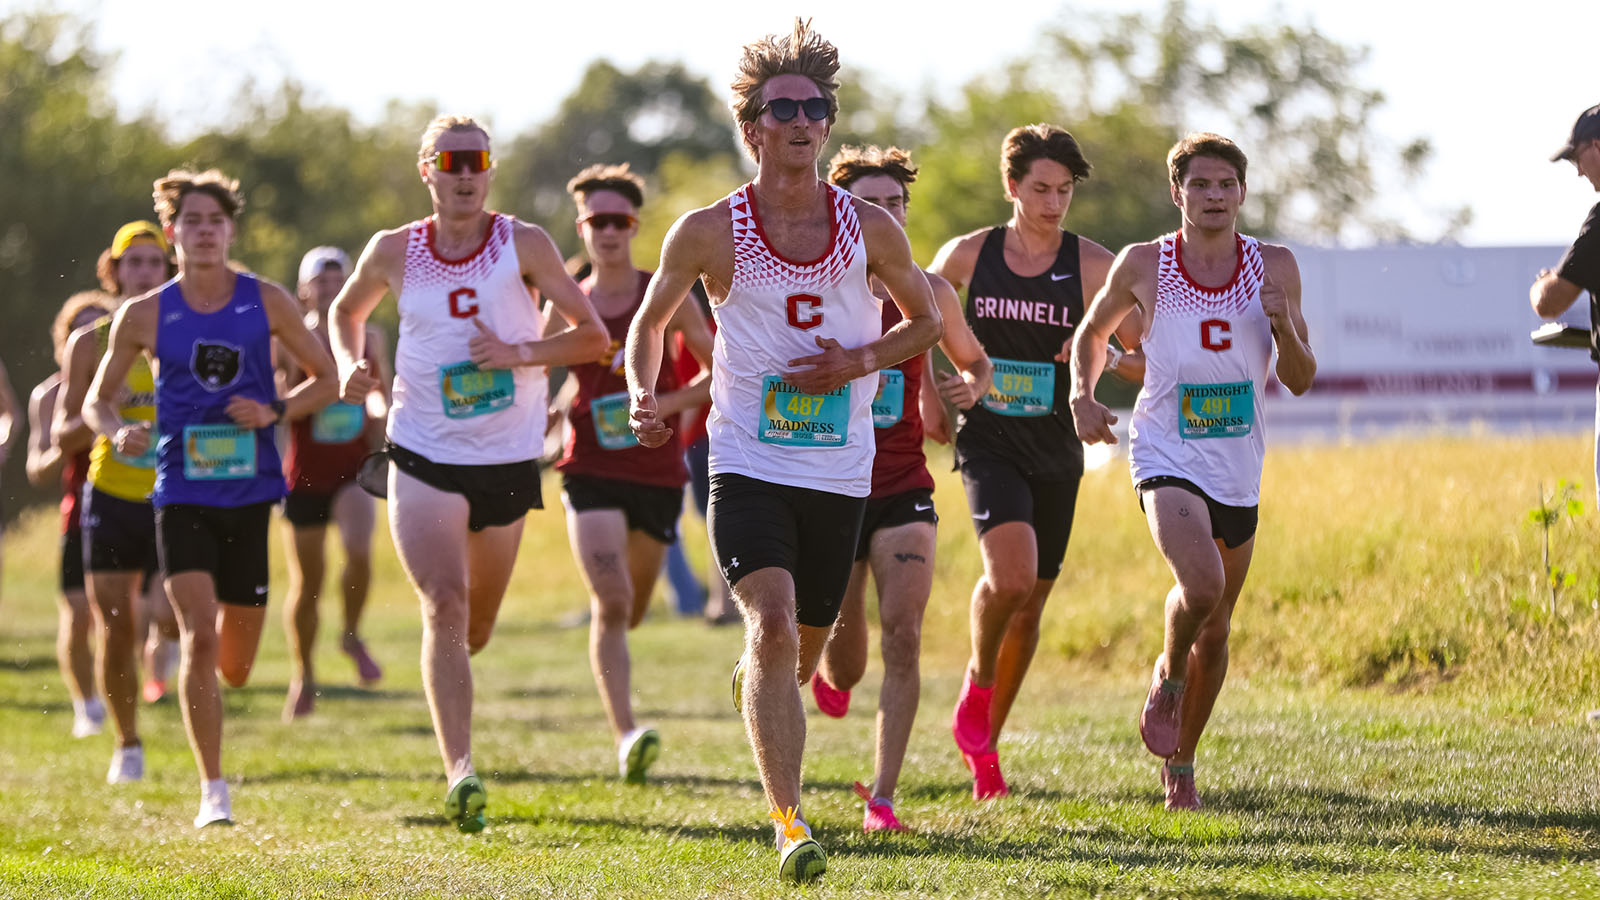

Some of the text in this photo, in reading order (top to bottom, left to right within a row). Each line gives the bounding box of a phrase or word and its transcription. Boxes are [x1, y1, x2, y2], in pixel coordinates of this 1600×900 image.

[449, 287, 479, 318] C
[786, 293, 824, 331] C
[975, 296, 1074, 328] GRINNELL
[1200, 319, 1232, 351] C
[1002, 375, 1033, 393] 575
[1184, 384, 1250, 398] MIDNIGHT
[787, 395, 825, 417] 487
[988, 394, 1042, 405] MADNESS
[1201, 397, 1231, 415] 491
[768, 419, 835, 434] MADNESS
[1187, 416, 1244, 428] MADNESS
